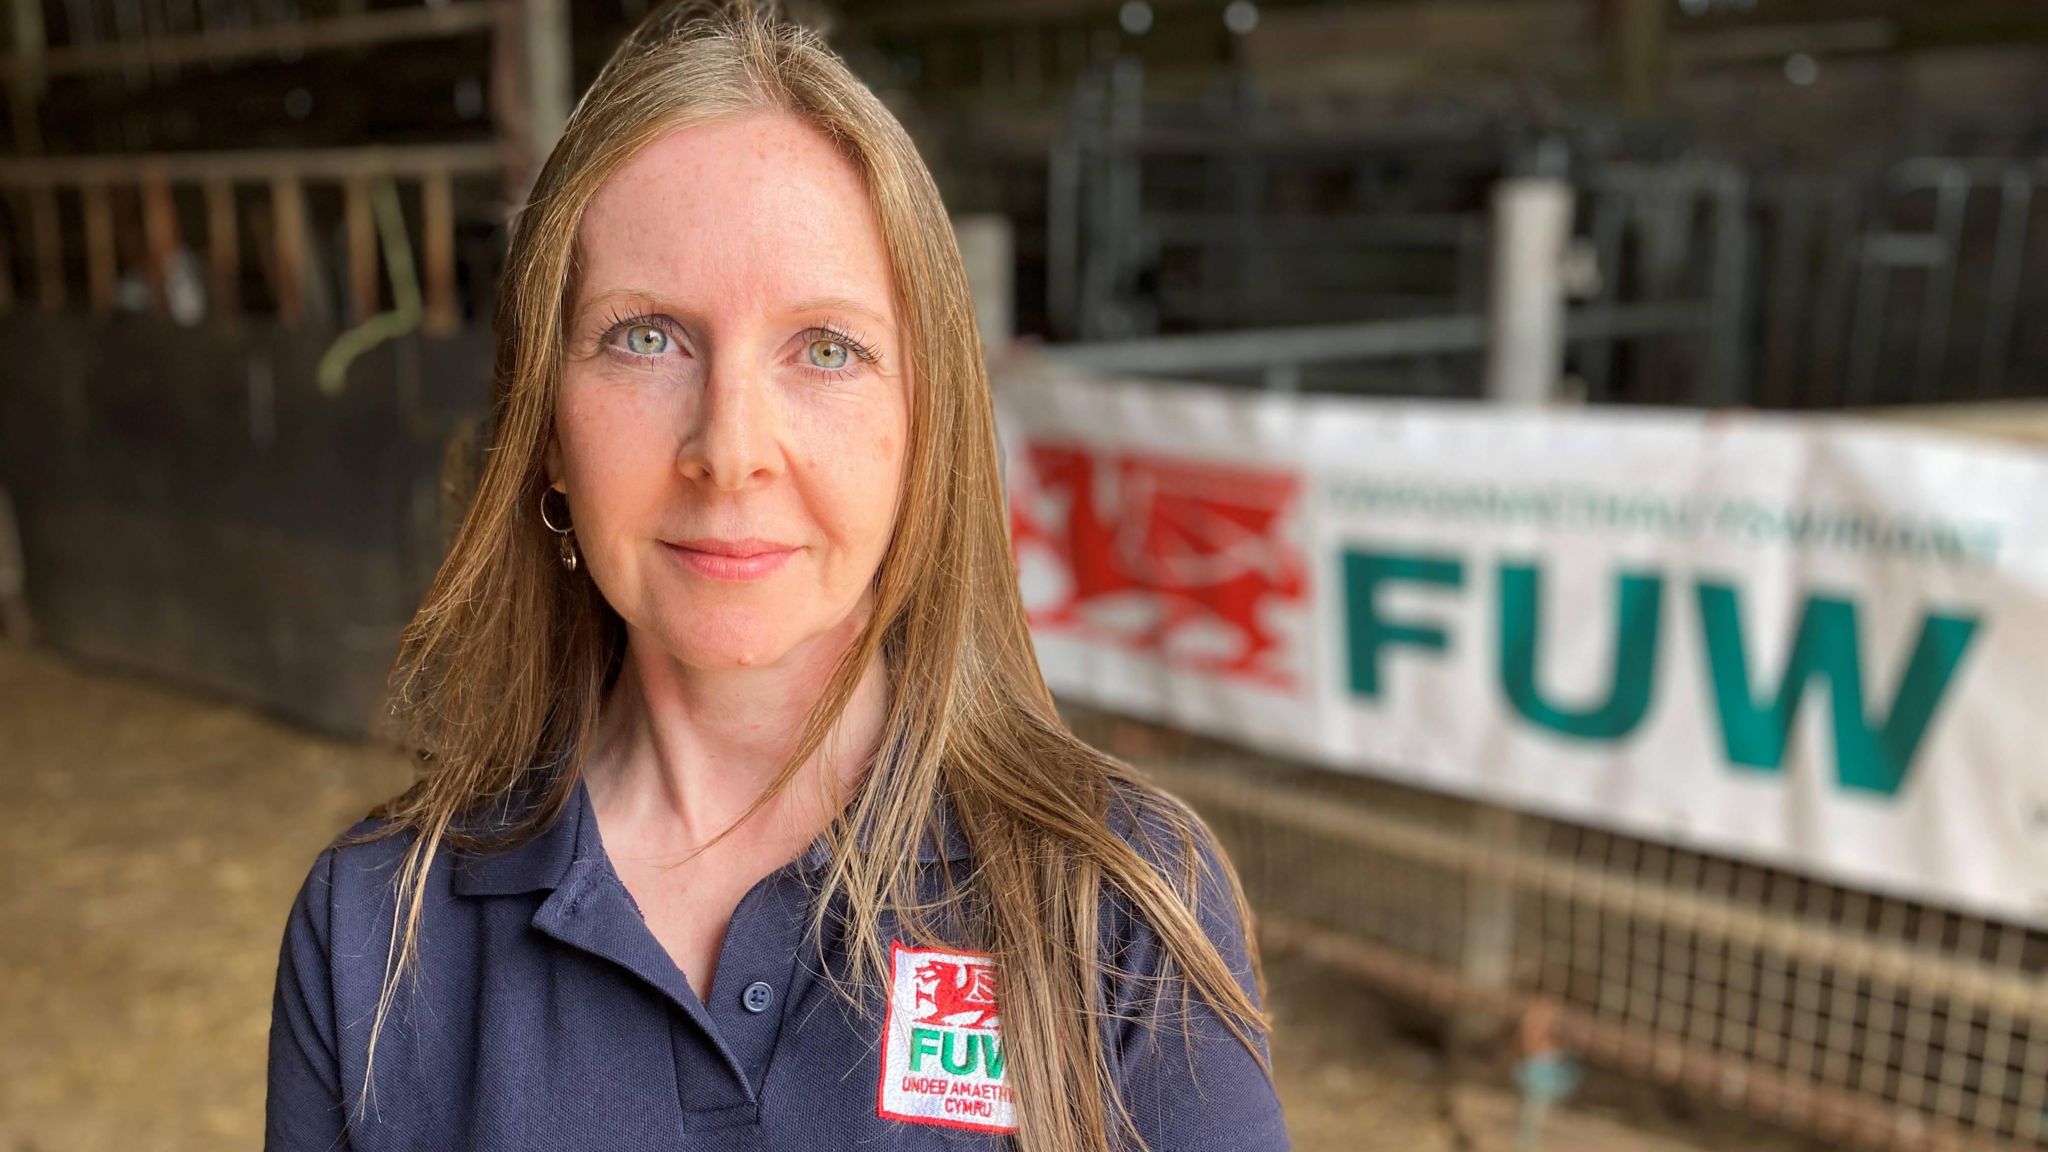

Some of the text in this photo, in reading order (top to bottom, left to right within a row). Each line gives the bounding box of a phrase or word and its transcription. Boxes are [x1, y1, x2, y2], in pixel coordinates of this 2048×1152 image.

[1340, 545, 1983, 797] FUW
[902, 1076, 948, 1095] UNDEB
[945, 1097, 992, 1118] CYMRU
